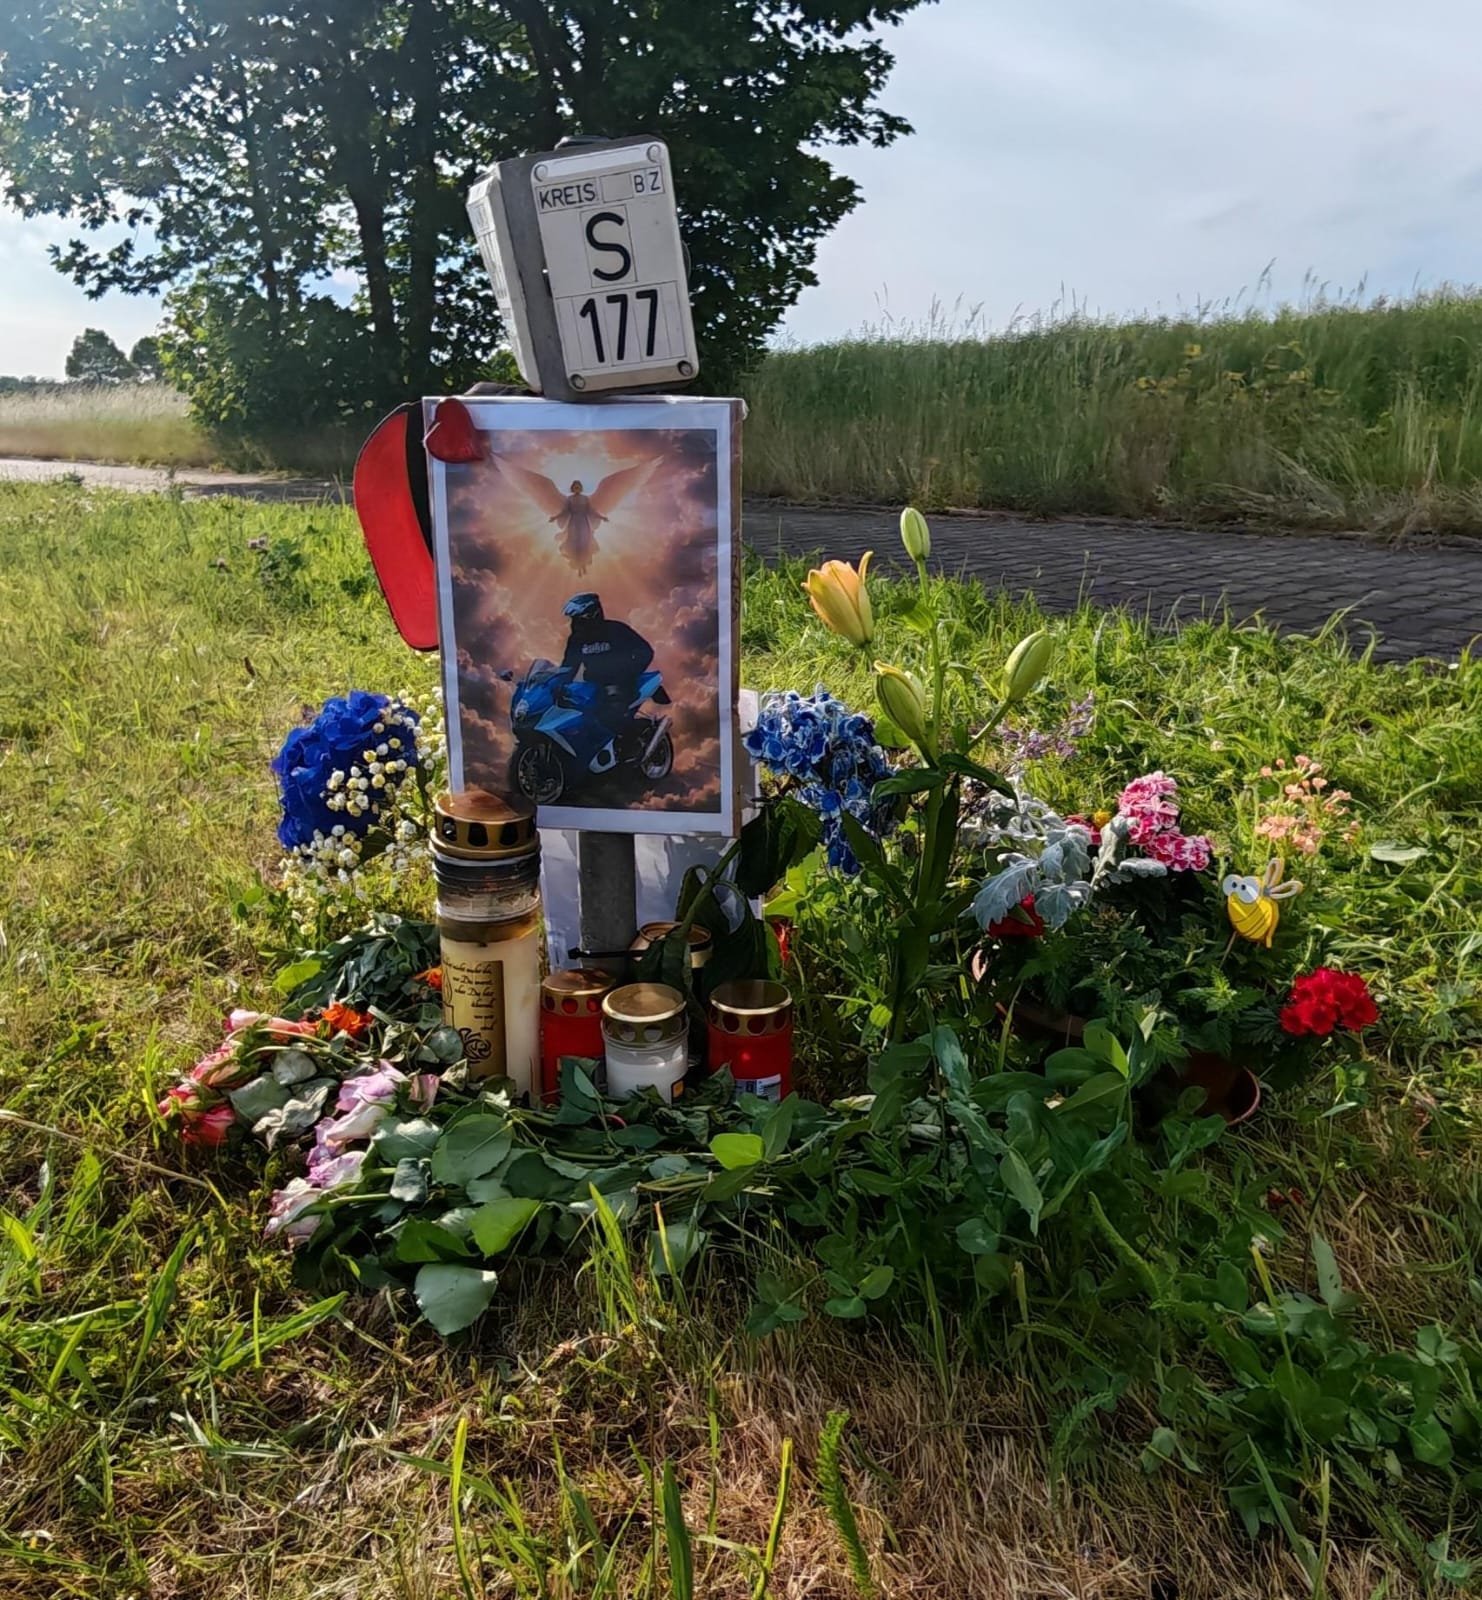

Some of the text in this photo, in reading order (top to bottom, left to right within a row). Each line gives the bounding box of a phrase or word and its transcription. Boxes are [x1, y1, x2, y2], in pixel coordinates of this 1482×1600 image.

[539, 183, 596, 209] KREIS
[585, 211, 632, 282] S
[579, 289, 659, 363] 177
